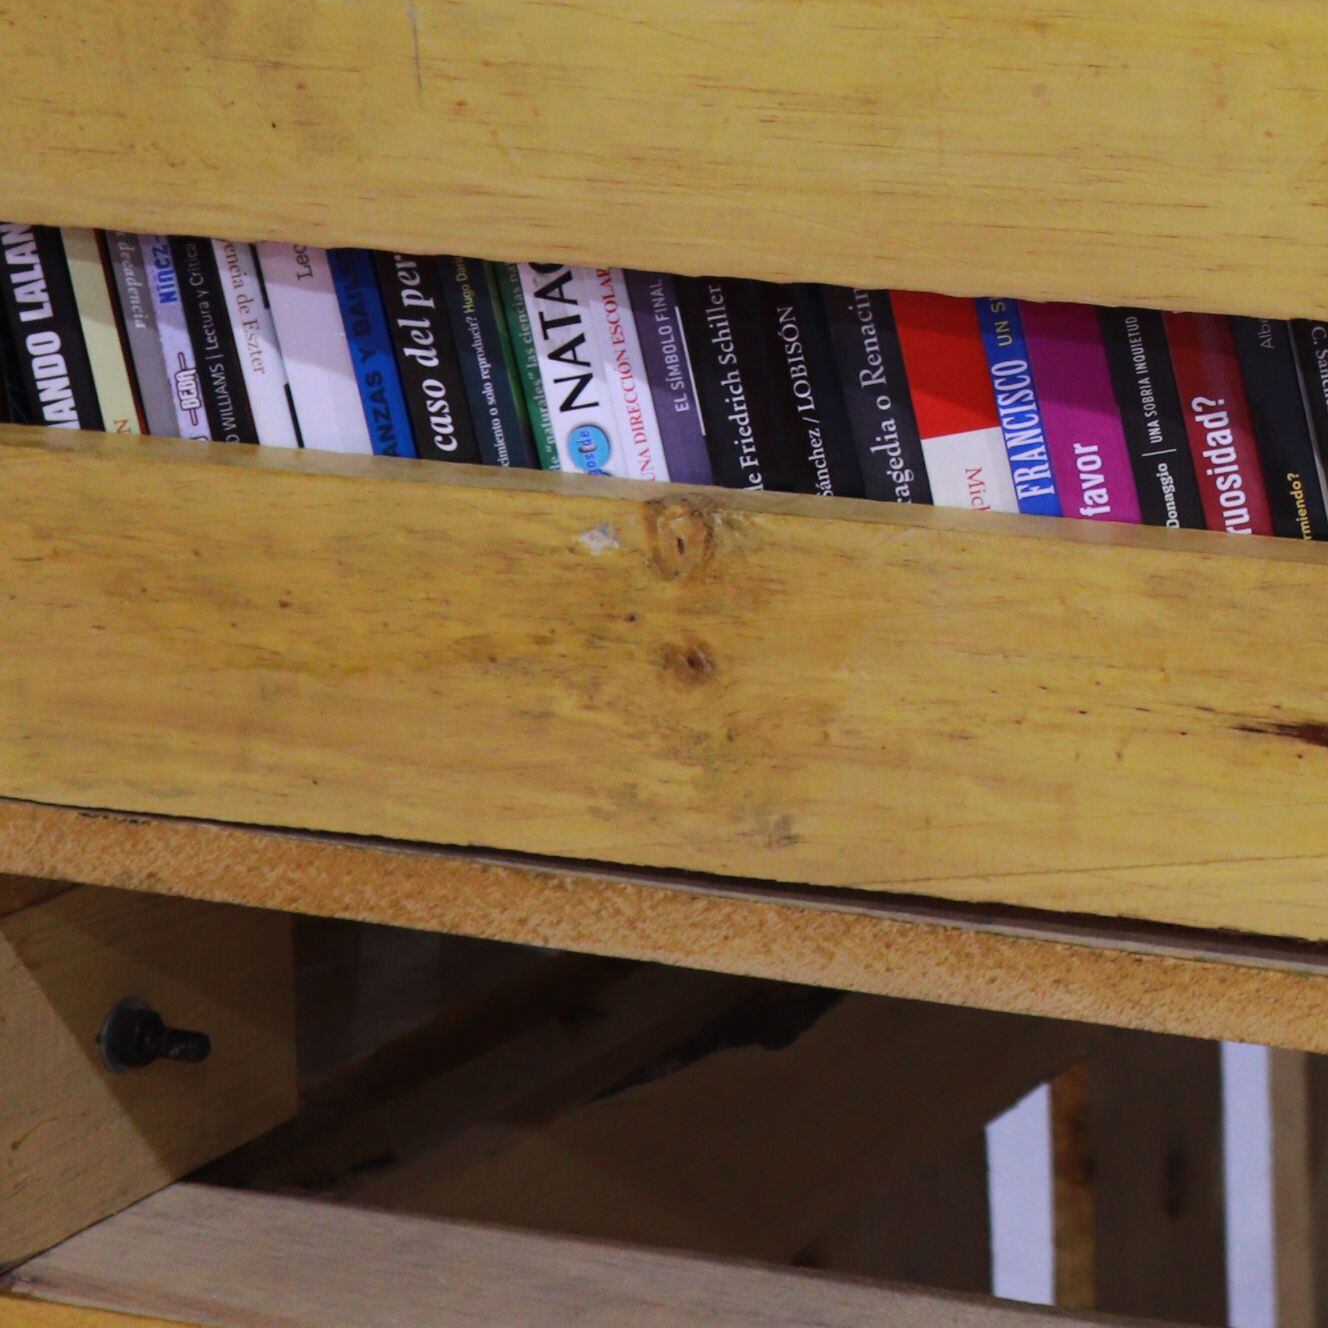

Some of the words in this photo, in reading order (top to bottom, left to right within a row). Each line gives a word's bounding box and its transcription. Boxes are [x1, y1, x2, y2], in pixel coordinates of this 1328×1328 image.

[236, 294, 255, 315] de
[462, 281, 477, 315] Hugo
[511, 291, 534, 344] ciencias
[649, 277, 671, 323] FINAL
[705, 283, 738, 366] Schiller
[201, 300, 221, 352] Lectura
[242, 317, 266, 375] Eszter
[396, 317, 440, 368] del
[466, 315, 492, 381] reproducir?
[997, 320, 1014, 347] UN
[1124, 315, 1150, 375] INQUIETUD
[1311, 324, 1328, 347] C.
[26, 331, 81, 429] ANDO
[360, 346, 376, 364] Y
[658, 326, 686, 391] SÍMBOLO
[776, 306, 816, 413] LOBISÓN
[211, 362, 237, 430] WILLIAMS
[425, 377, 458, 453] caso
[480, 378, 497, 408] solo
[615, 348, 647, 445] DIRECCIÓN
[675, 394, 690, 413] EL
[721, 369, 760, 469] Friedrich
[875, 395, 893, 411] o
[1139, 375, 1160, 419] SOBRIA
[990, 359, 1057, 501] FRANCISCO
[1149, 420, 1164, 444] UNA
[1073, 442, 1113, 518] favor
[1155, 462, 1182, 530] Donaggio
